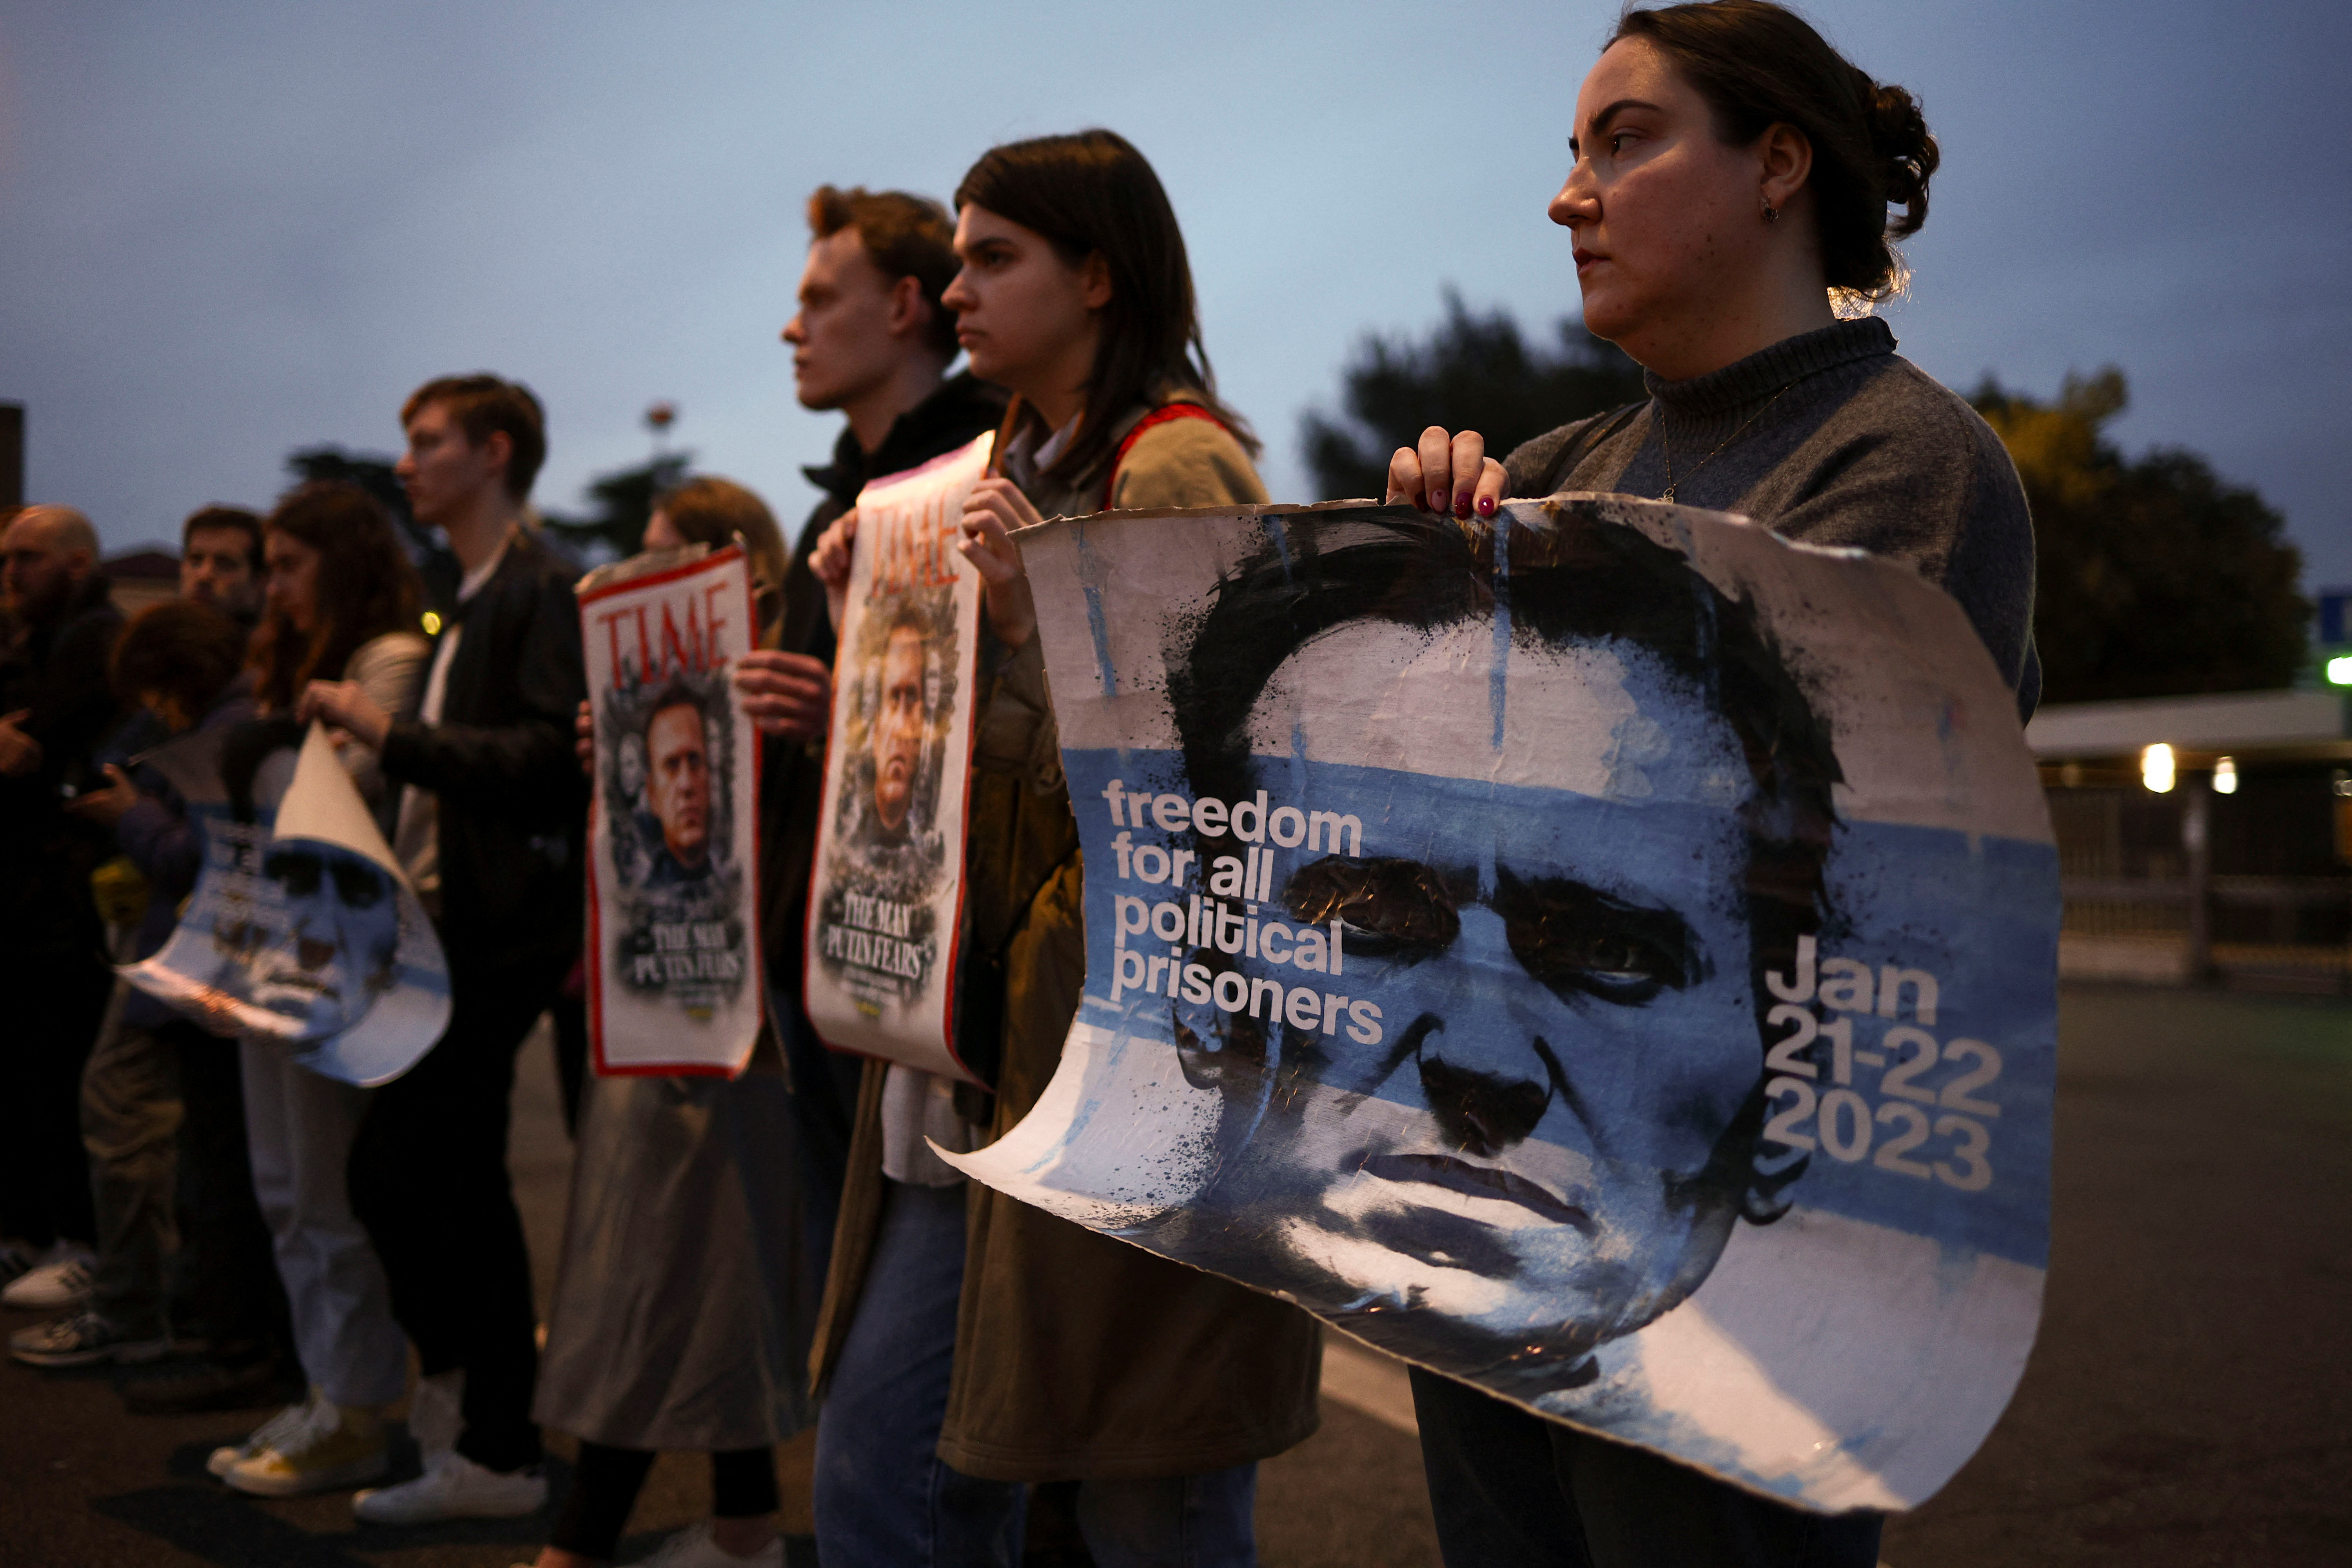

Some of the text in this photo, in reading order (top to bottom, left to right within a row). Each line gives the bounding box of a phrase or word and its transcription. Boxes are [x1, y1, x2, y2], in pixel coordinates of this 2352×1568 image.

[870, 487, 960, 598] TIME
[596, 580, 730, 690] TIME
[1102, 779, 1362, 858] freedom
[1111, 831, 1274, 903] for all
[844, 891, 913, 938] THE MAN
[872, 935, 922, 980] FEARS
[1114, 894, 1342, 976] political
[1110, 946, 1383, 1045] prisoners
[1765, 934, 1939, 1026] Jan
[1765, 1004, 2003, 1118] 21-22
[1763, 1076, 1993, 1191] 2023
